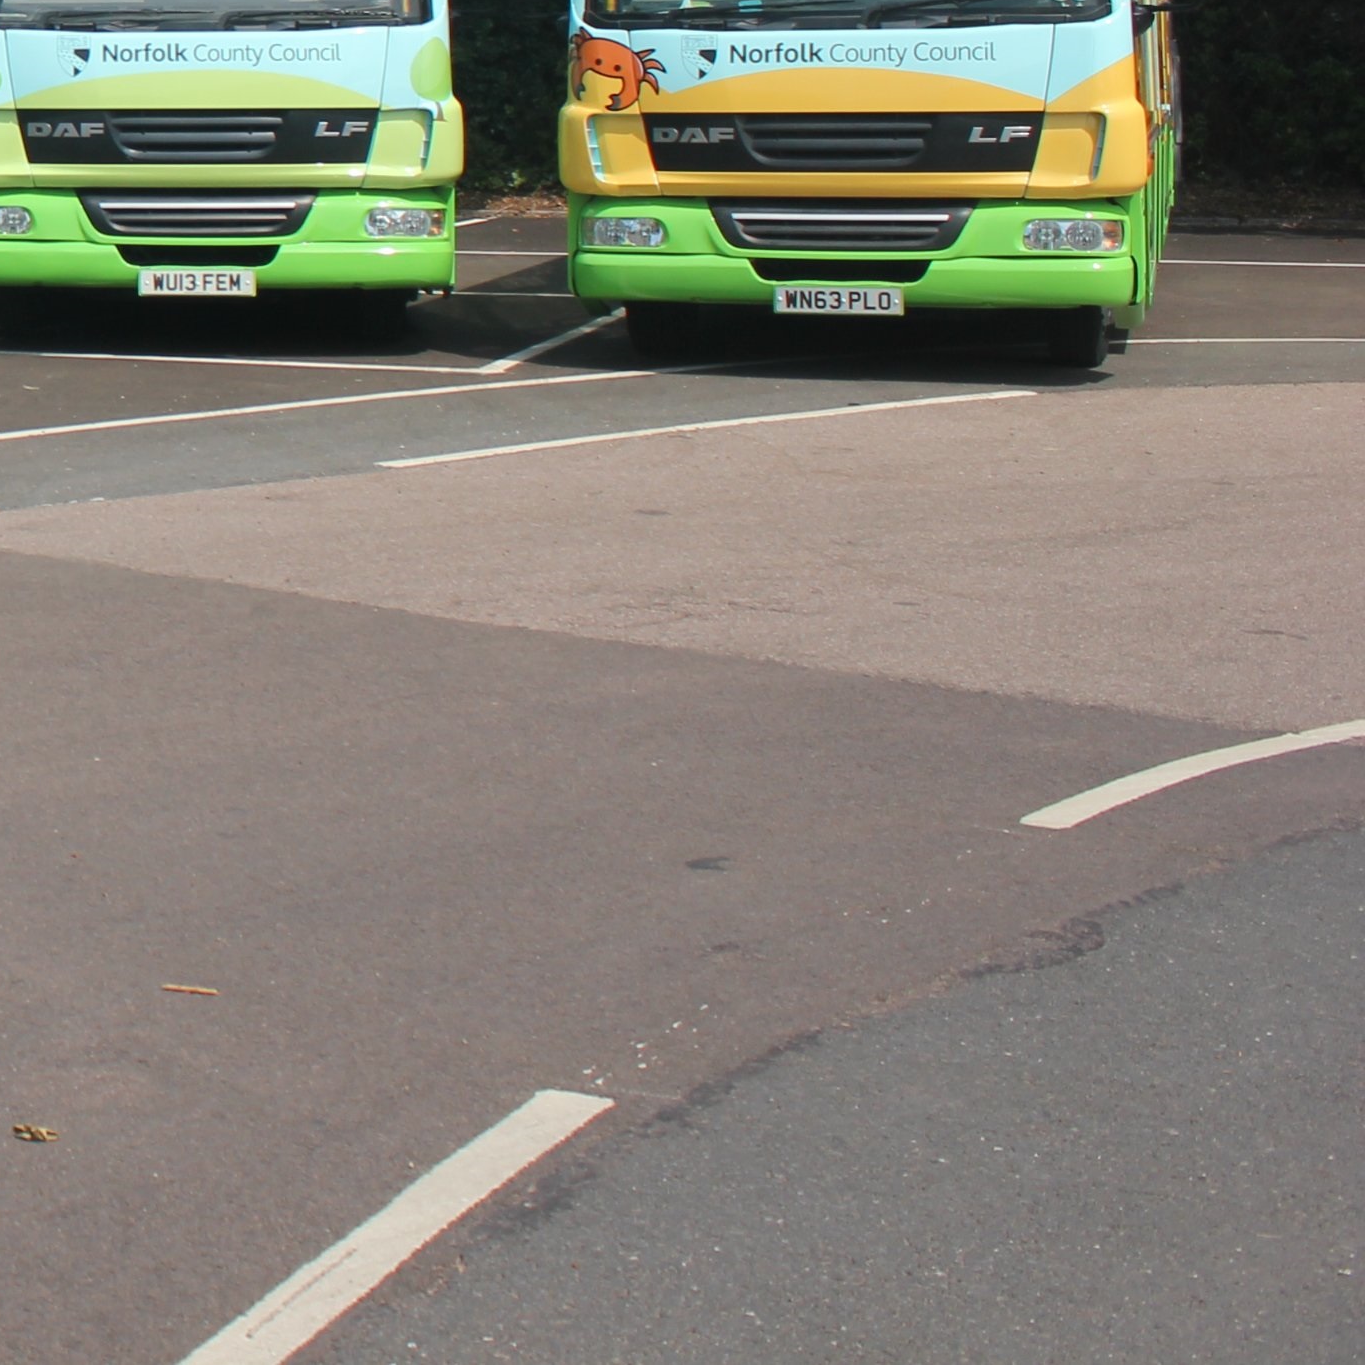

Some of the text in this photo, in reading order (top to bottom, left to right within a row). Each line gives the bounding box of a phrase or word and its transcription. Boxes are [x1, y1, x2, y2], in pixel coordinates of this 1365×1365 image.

[102, 43, 341, 67] Norfolk County Council
[730, 42, 997, 67] Norfolk County Council
[26, 122, 105, 139] DAF
[314, 121, 369, 138] LF
[652, 127, 736, 144] DAF
[969, 126, 1032, 144] LF
[152, 273, 242, 292] WU13 FEM
[785, 289, 892, 310] WN63 PLO
